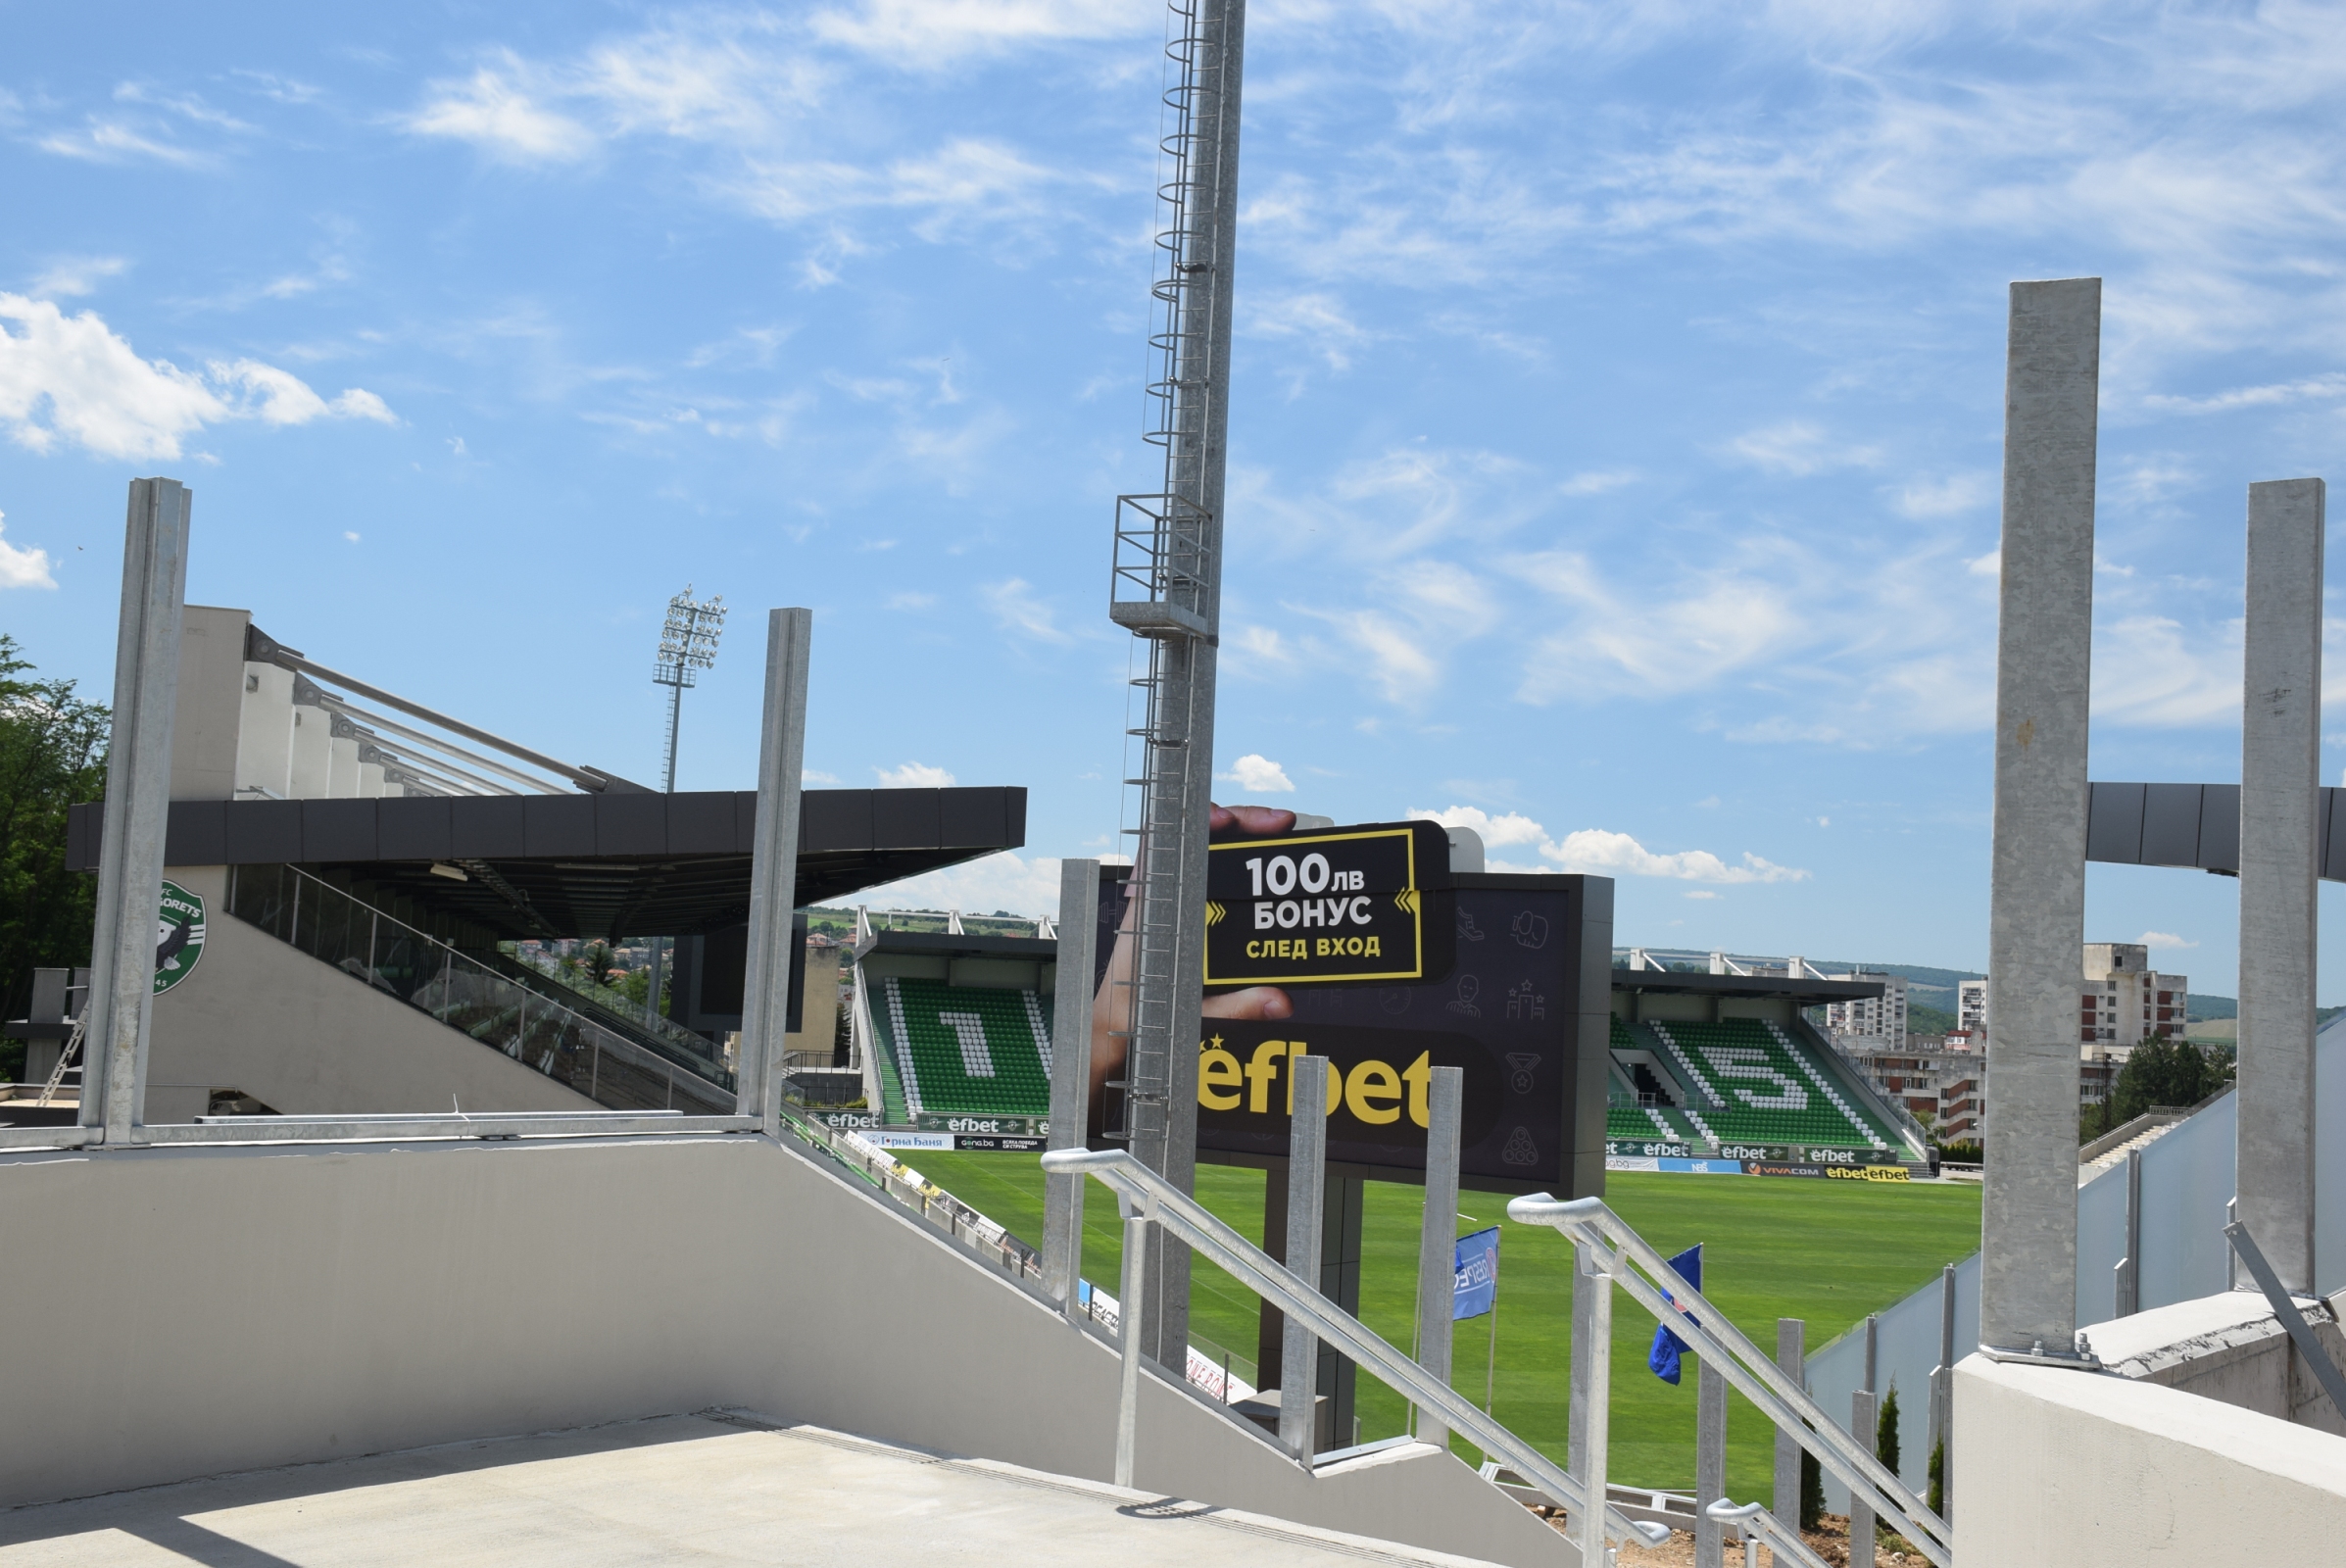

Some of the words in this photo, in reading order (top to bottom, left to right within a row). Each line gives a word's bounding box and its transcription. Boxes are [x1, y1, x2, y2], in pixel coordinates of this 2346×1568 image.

[1254, 896, 1372, 930] БОНУС
[1246, 939, 1307, 960] СЛЕД
[1316, 936, 1381, 957] ВХОД
[827, 1113, 880, 1129] efbet
[947, 1118, 1000, 1133] efbet
[1643, 1143, 1689, 1157] efbet
[1721, 1146, 1767, 1160] efbet
[1810, 1149, 1855, 1163] efbet
[1763, 1167, 1819, 1176] VIVACOM
[1826, 1167, 1869, 1180] efbet
[1870, 1168, 1910, 1181] efbet
